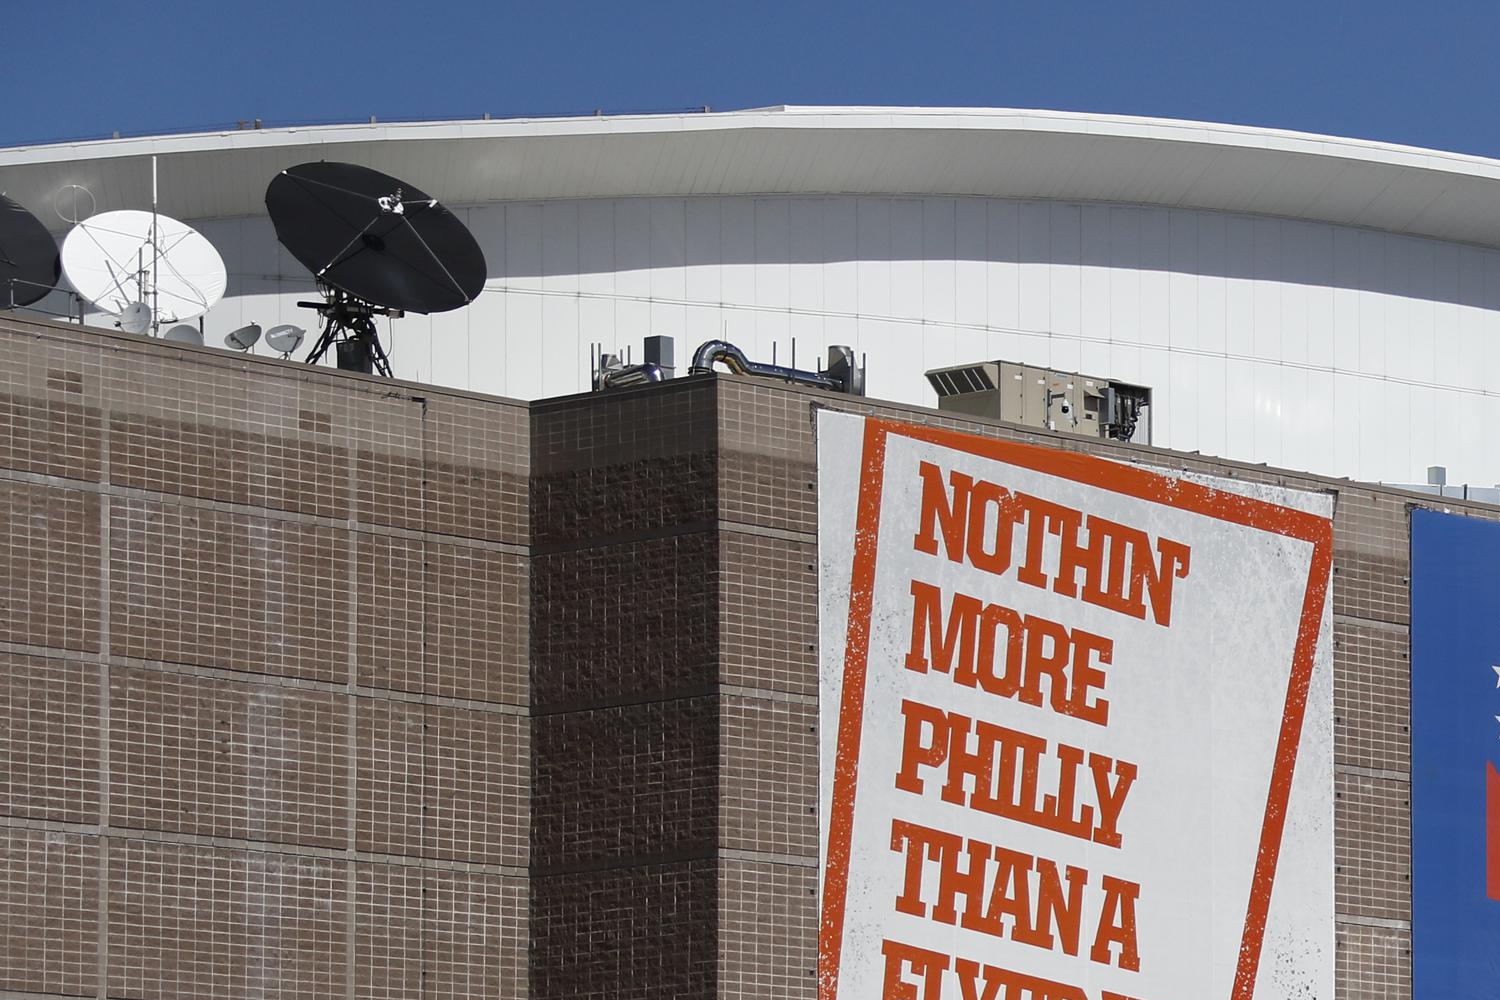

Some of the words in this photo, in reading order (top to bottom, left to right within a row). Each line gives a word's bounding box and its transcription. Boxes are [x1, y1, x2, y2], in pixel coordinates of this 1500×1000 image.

[914, 461, 1190, 627] NOTHIN'
[904, 580, 1113, 727] MORE
[895, 698, 1137, 849] PHILLY
[890, 819, 1087, 957] THAN
[1091, 874, 1140, 972] A
